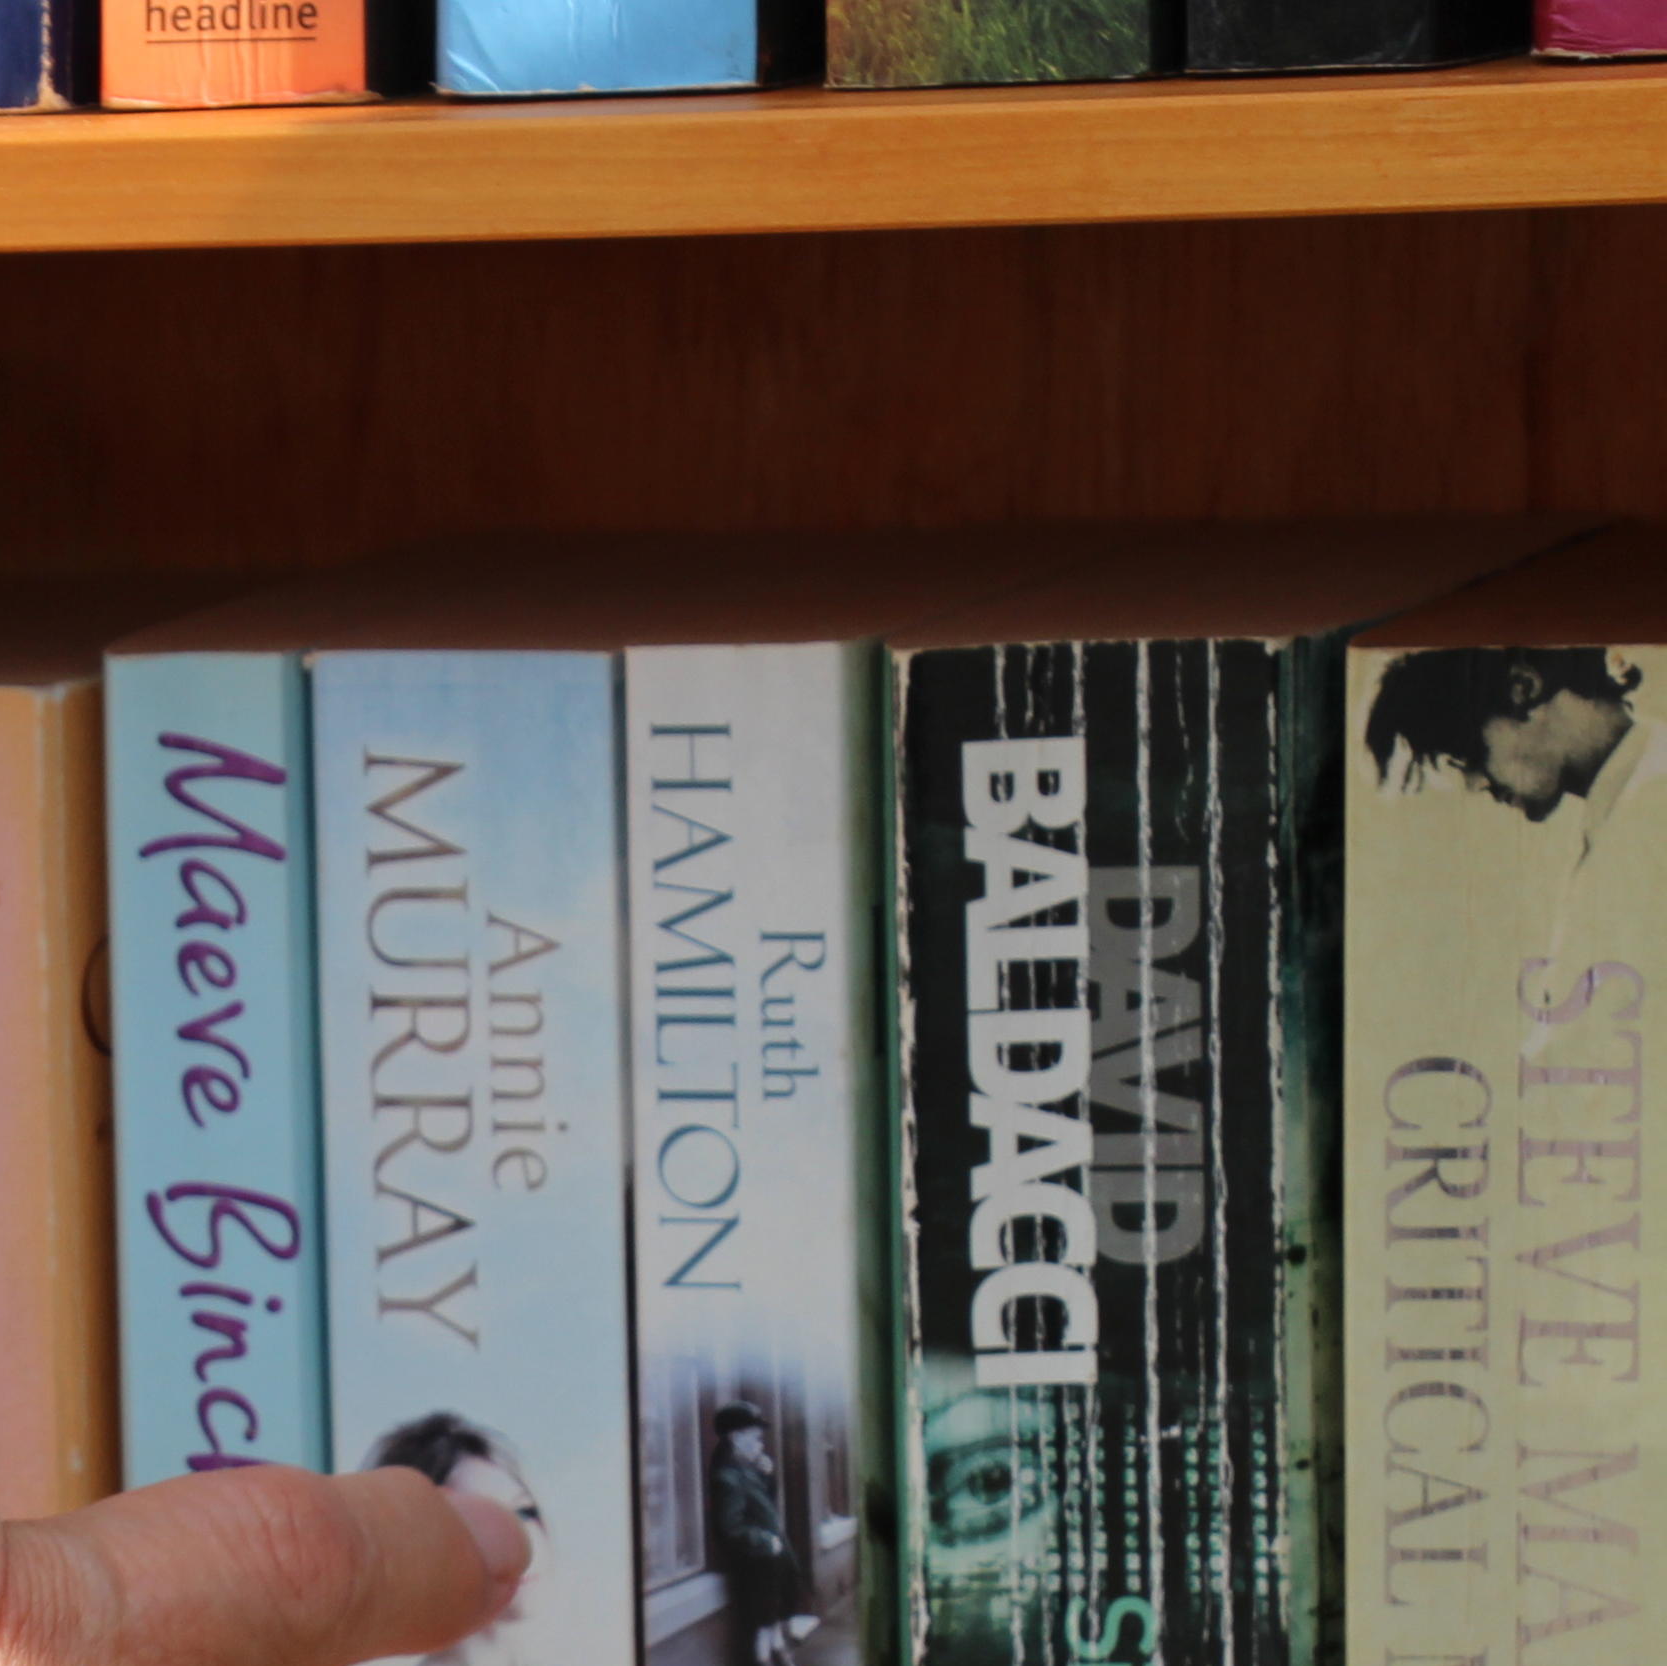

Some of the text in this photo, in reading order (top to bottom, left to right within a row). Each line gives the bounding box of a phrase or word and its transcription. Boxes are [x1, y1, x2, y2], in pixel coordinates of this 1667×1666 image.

[145, 0, 318, 31] headline
[138, 732, 302, 1472] Maeve Binc
[363, 746, 480, 1352] MURRAY
[486, 906, 569, 1193] Annie
[649, 722, 744, 1294] HAMILTON
[759, 930, 827, 1100] Ruth
[961, 736, 1100, 1388] BALDACCI
[1087, 865, 1206, 1267] DAVID
[1515, 956, 1647, 1386] STEVE
[1382, 1055, 1493, 1607] CRITICAL
